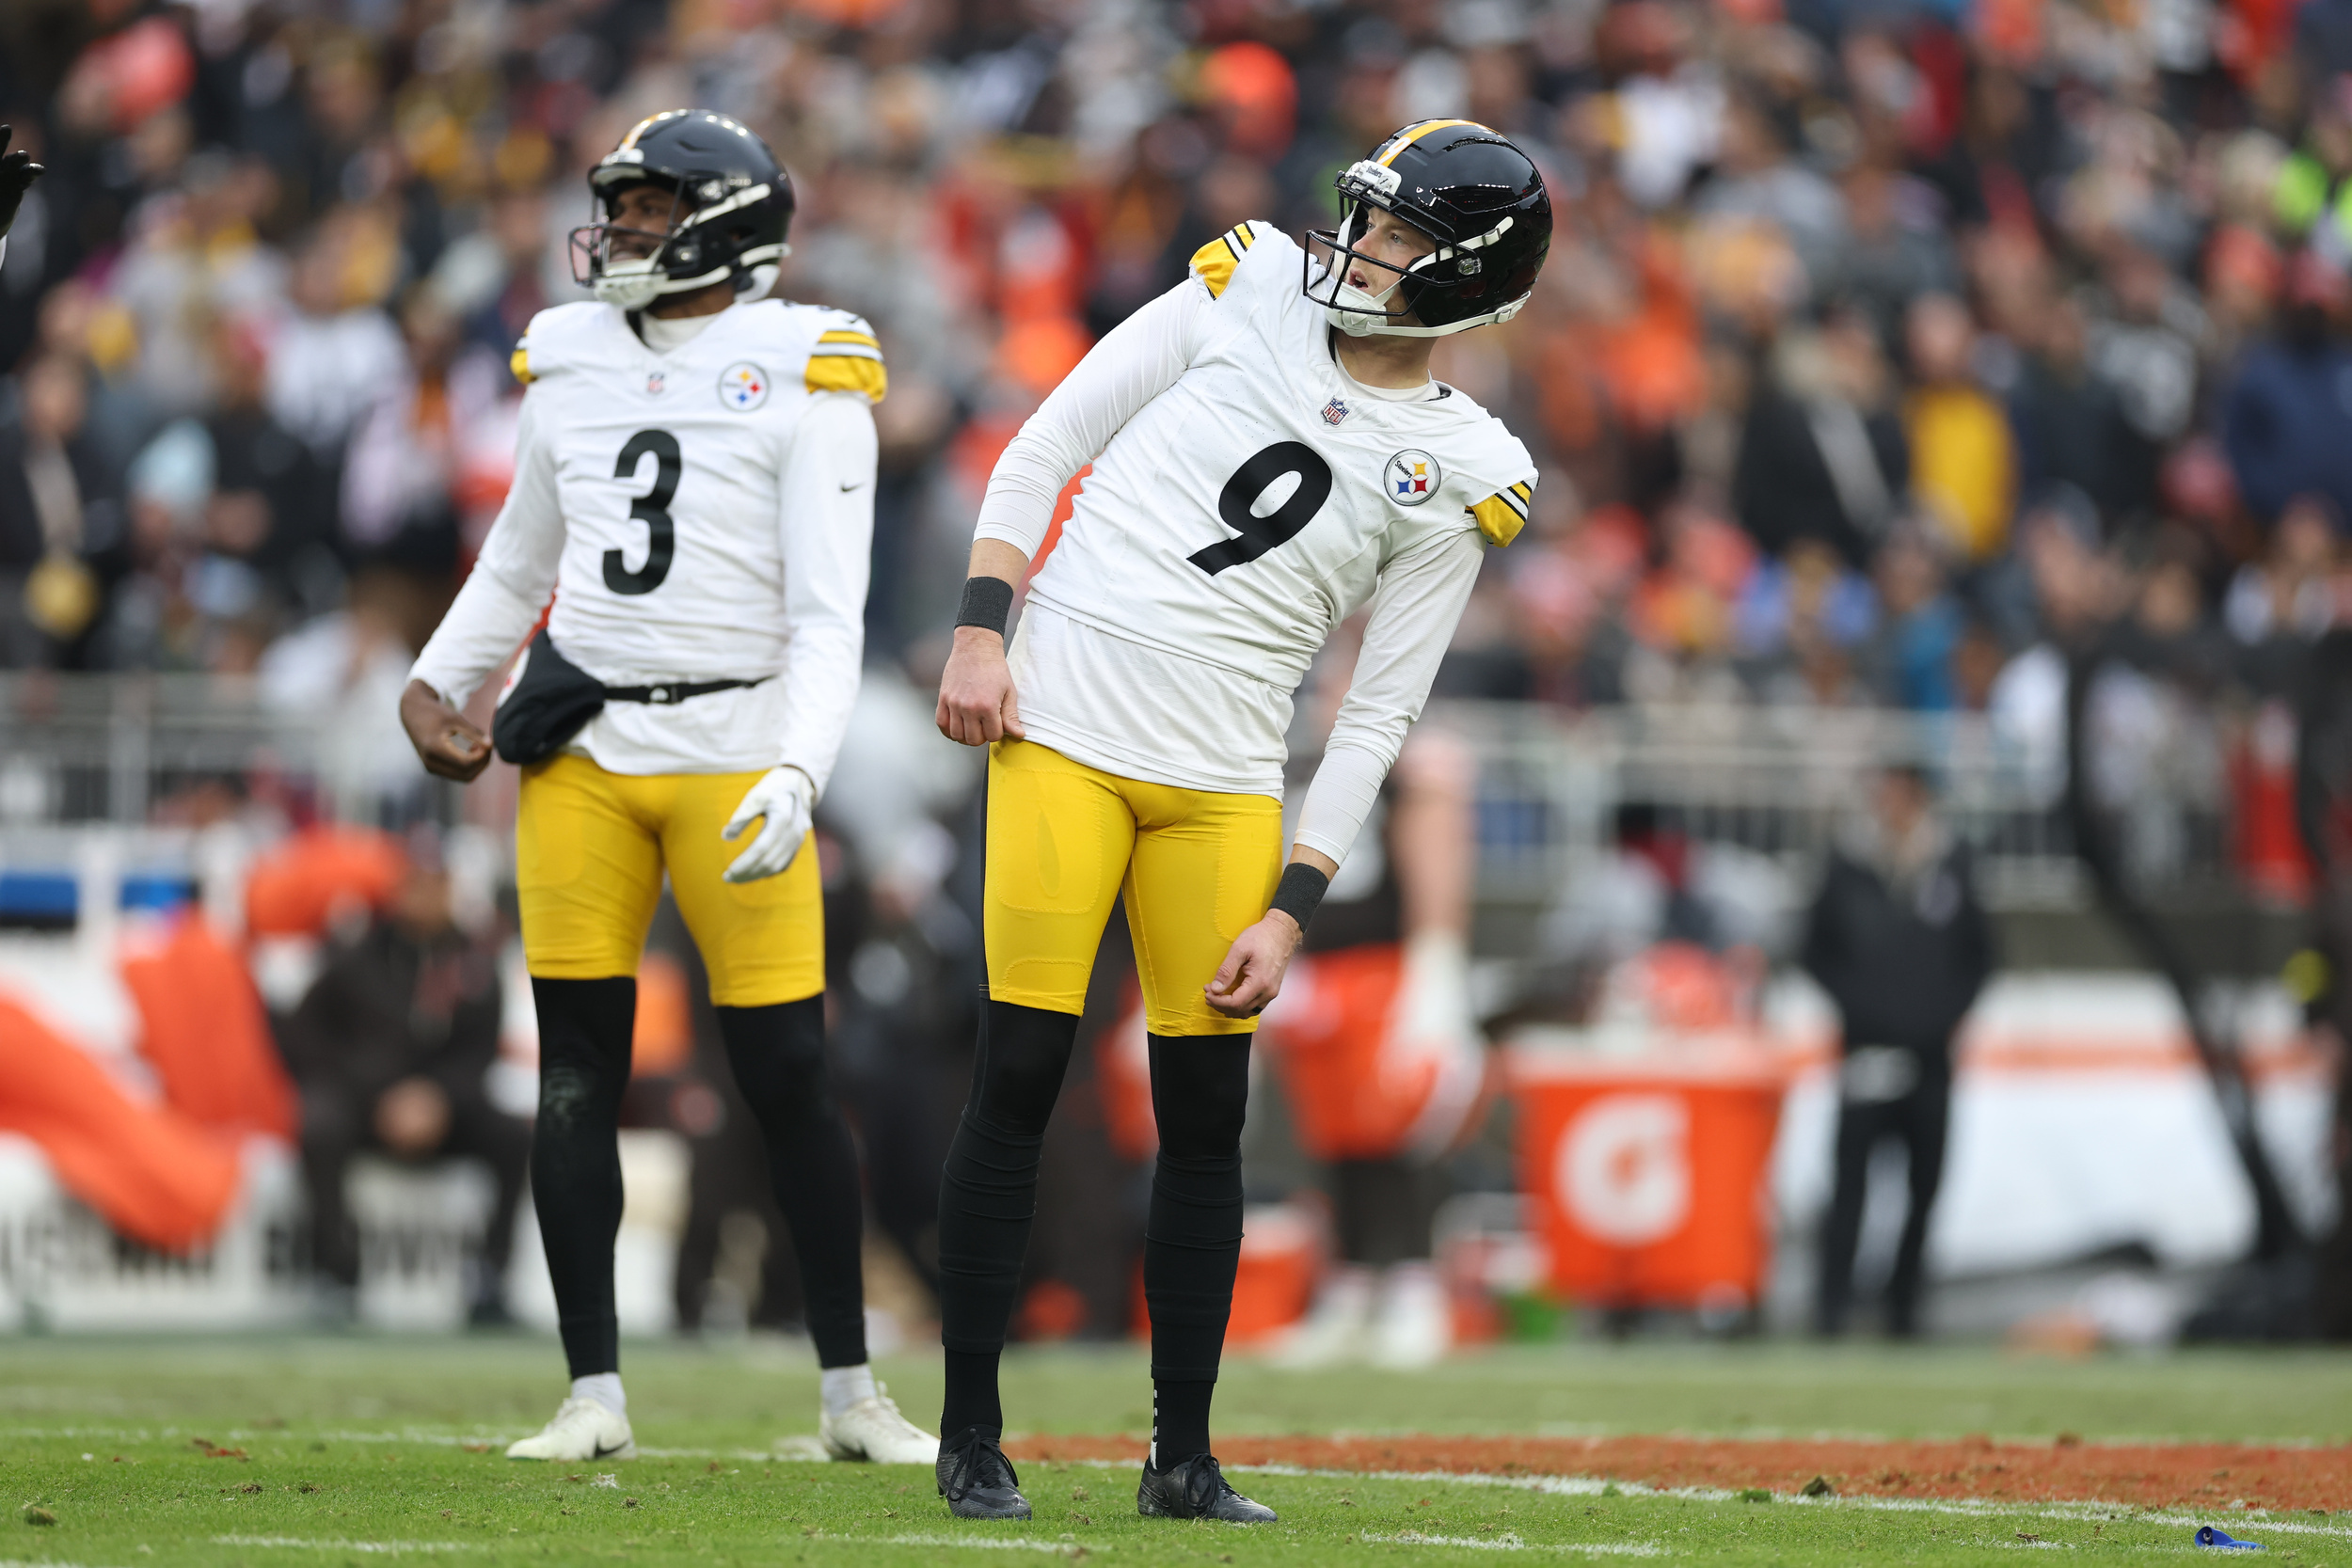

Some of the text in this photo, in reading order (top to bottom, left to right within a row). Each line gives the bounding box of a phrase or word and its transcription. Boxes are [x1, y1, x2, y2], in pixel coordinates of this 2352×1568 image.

[1376, 136, 1411, 165] 9
[1324, 405, 1341, 423] NFL
[1394, 460, 1413, 479] Steelers
[603, 429, 682, 595] 3
[1186, 440, 1332, 577] 9
